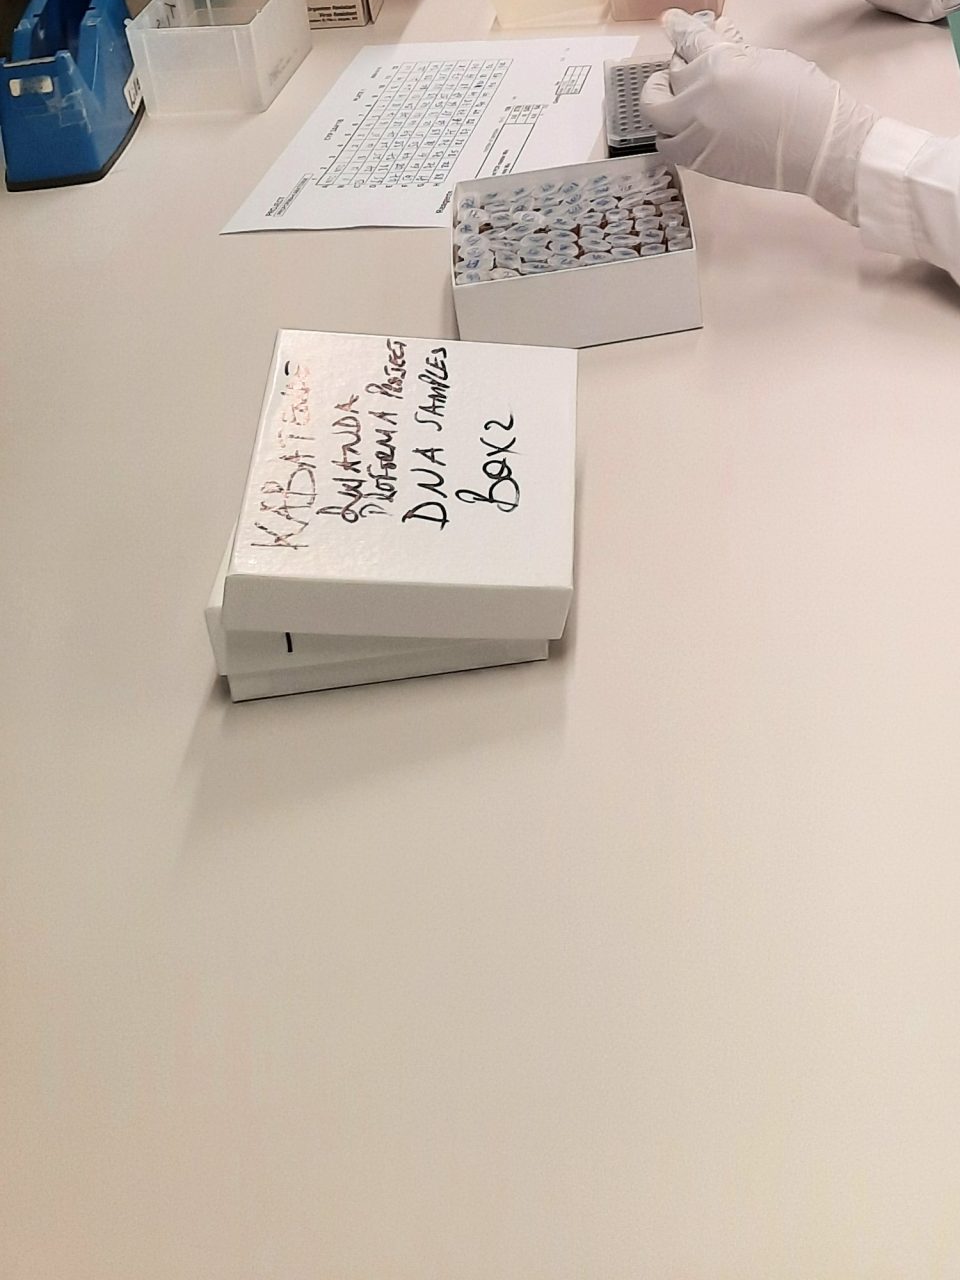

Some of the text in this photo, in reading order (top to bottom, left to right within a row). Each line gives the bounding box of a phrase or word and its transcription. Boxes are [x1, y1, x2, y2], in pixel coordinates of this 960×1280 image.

[401, 346, 451, 531] DNA SAMPLES
[483, 408, 516, 432] 2
